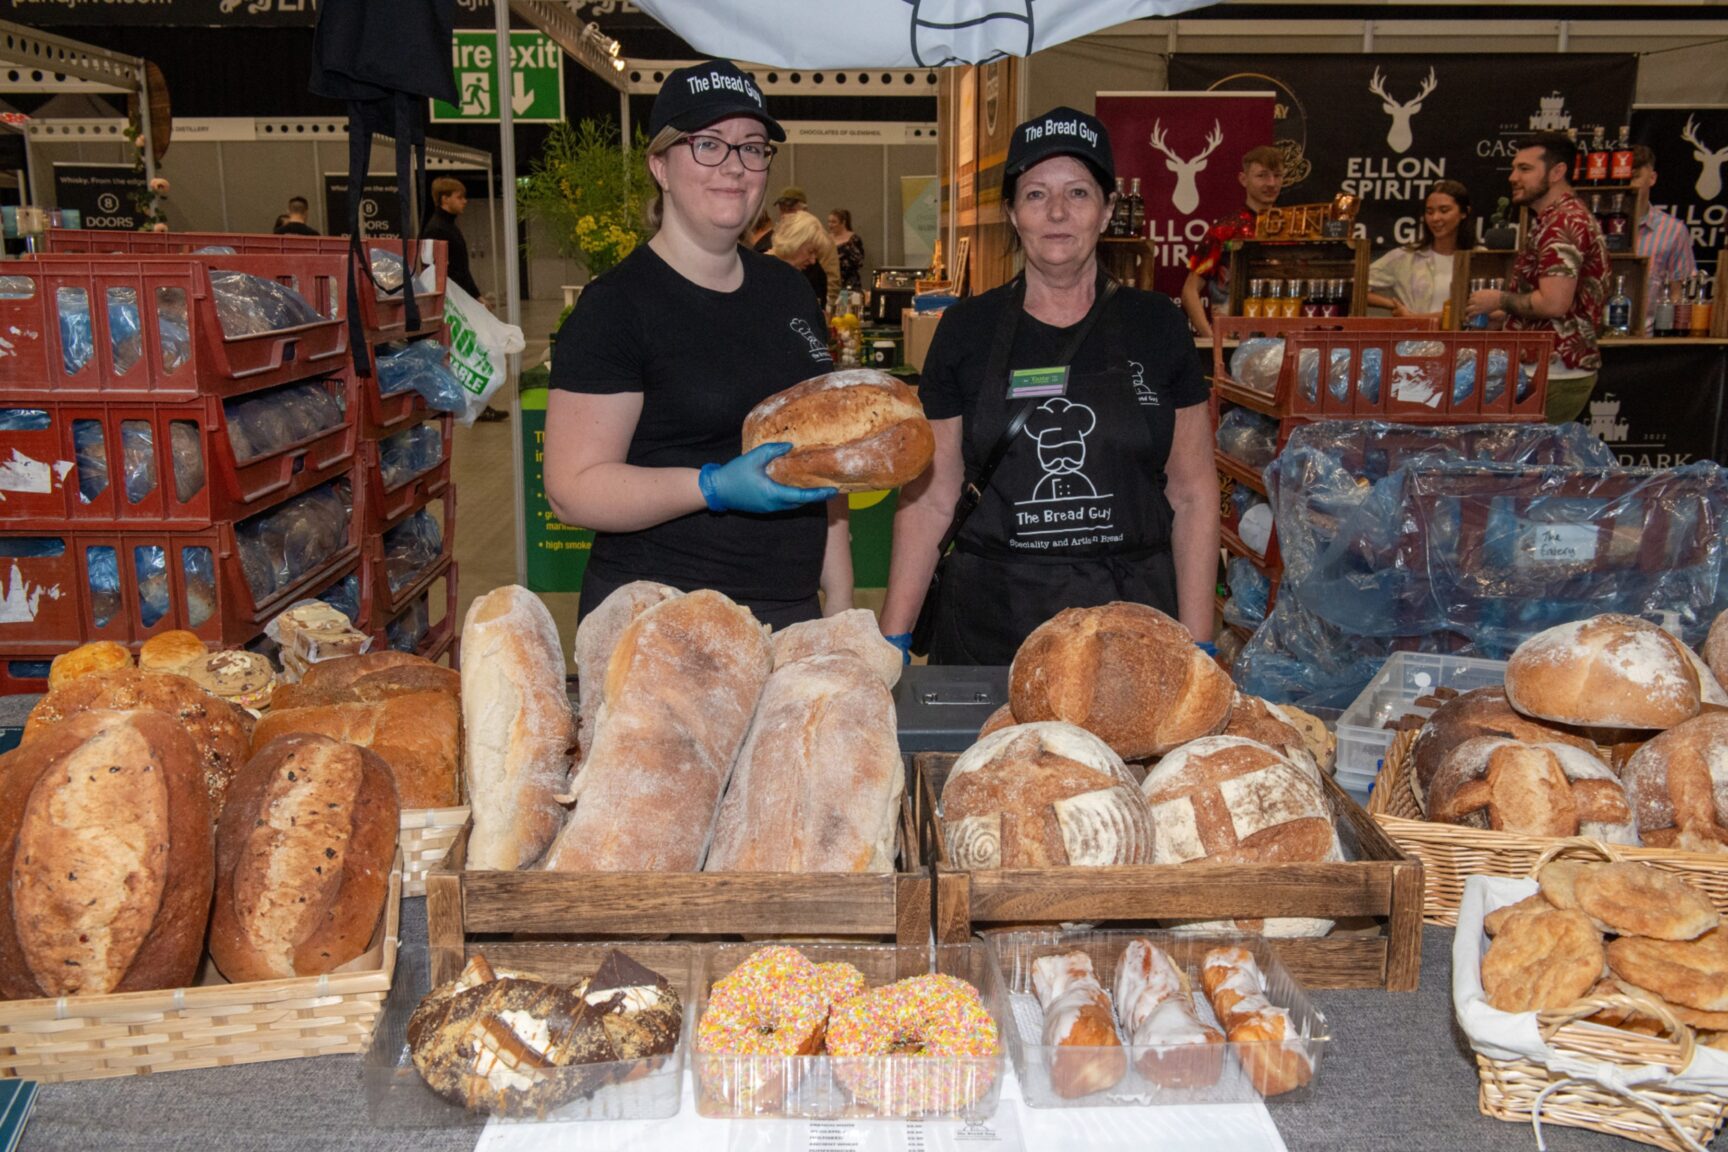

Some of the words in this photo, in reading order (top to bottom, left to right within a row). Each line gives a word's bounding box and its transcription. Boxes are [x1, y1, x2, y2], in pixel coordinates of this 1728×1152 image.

[452, 37, 492, 68] ire
[687, 75, 710, 94] The
[710, 71, 744, 93] Bread
[744, 80, 762, 108] Guy
[1025, 126, 1043, 143] The
[1045, 119, 1077, 136] Bread
[1079, 122, 1098, 148] Guy
[1346, 157, 1446, 178] ELLON
[1341, 180, 1444, 200] SPIRIT
[86, 216, 134, 227] DOORS
[1619, 453, 1692, 469] DARK
[1016, 511, 1040, 525] The
[1043, 506, 1084, 523] Bread
[1088, 507, 1112, 520] Guy
[545, 541, 563, 551] high
[565, 541, 592, 550] smoke
[1009, 538, 1050, 549] Speciality
[1052, 537, 1069, 547] and
